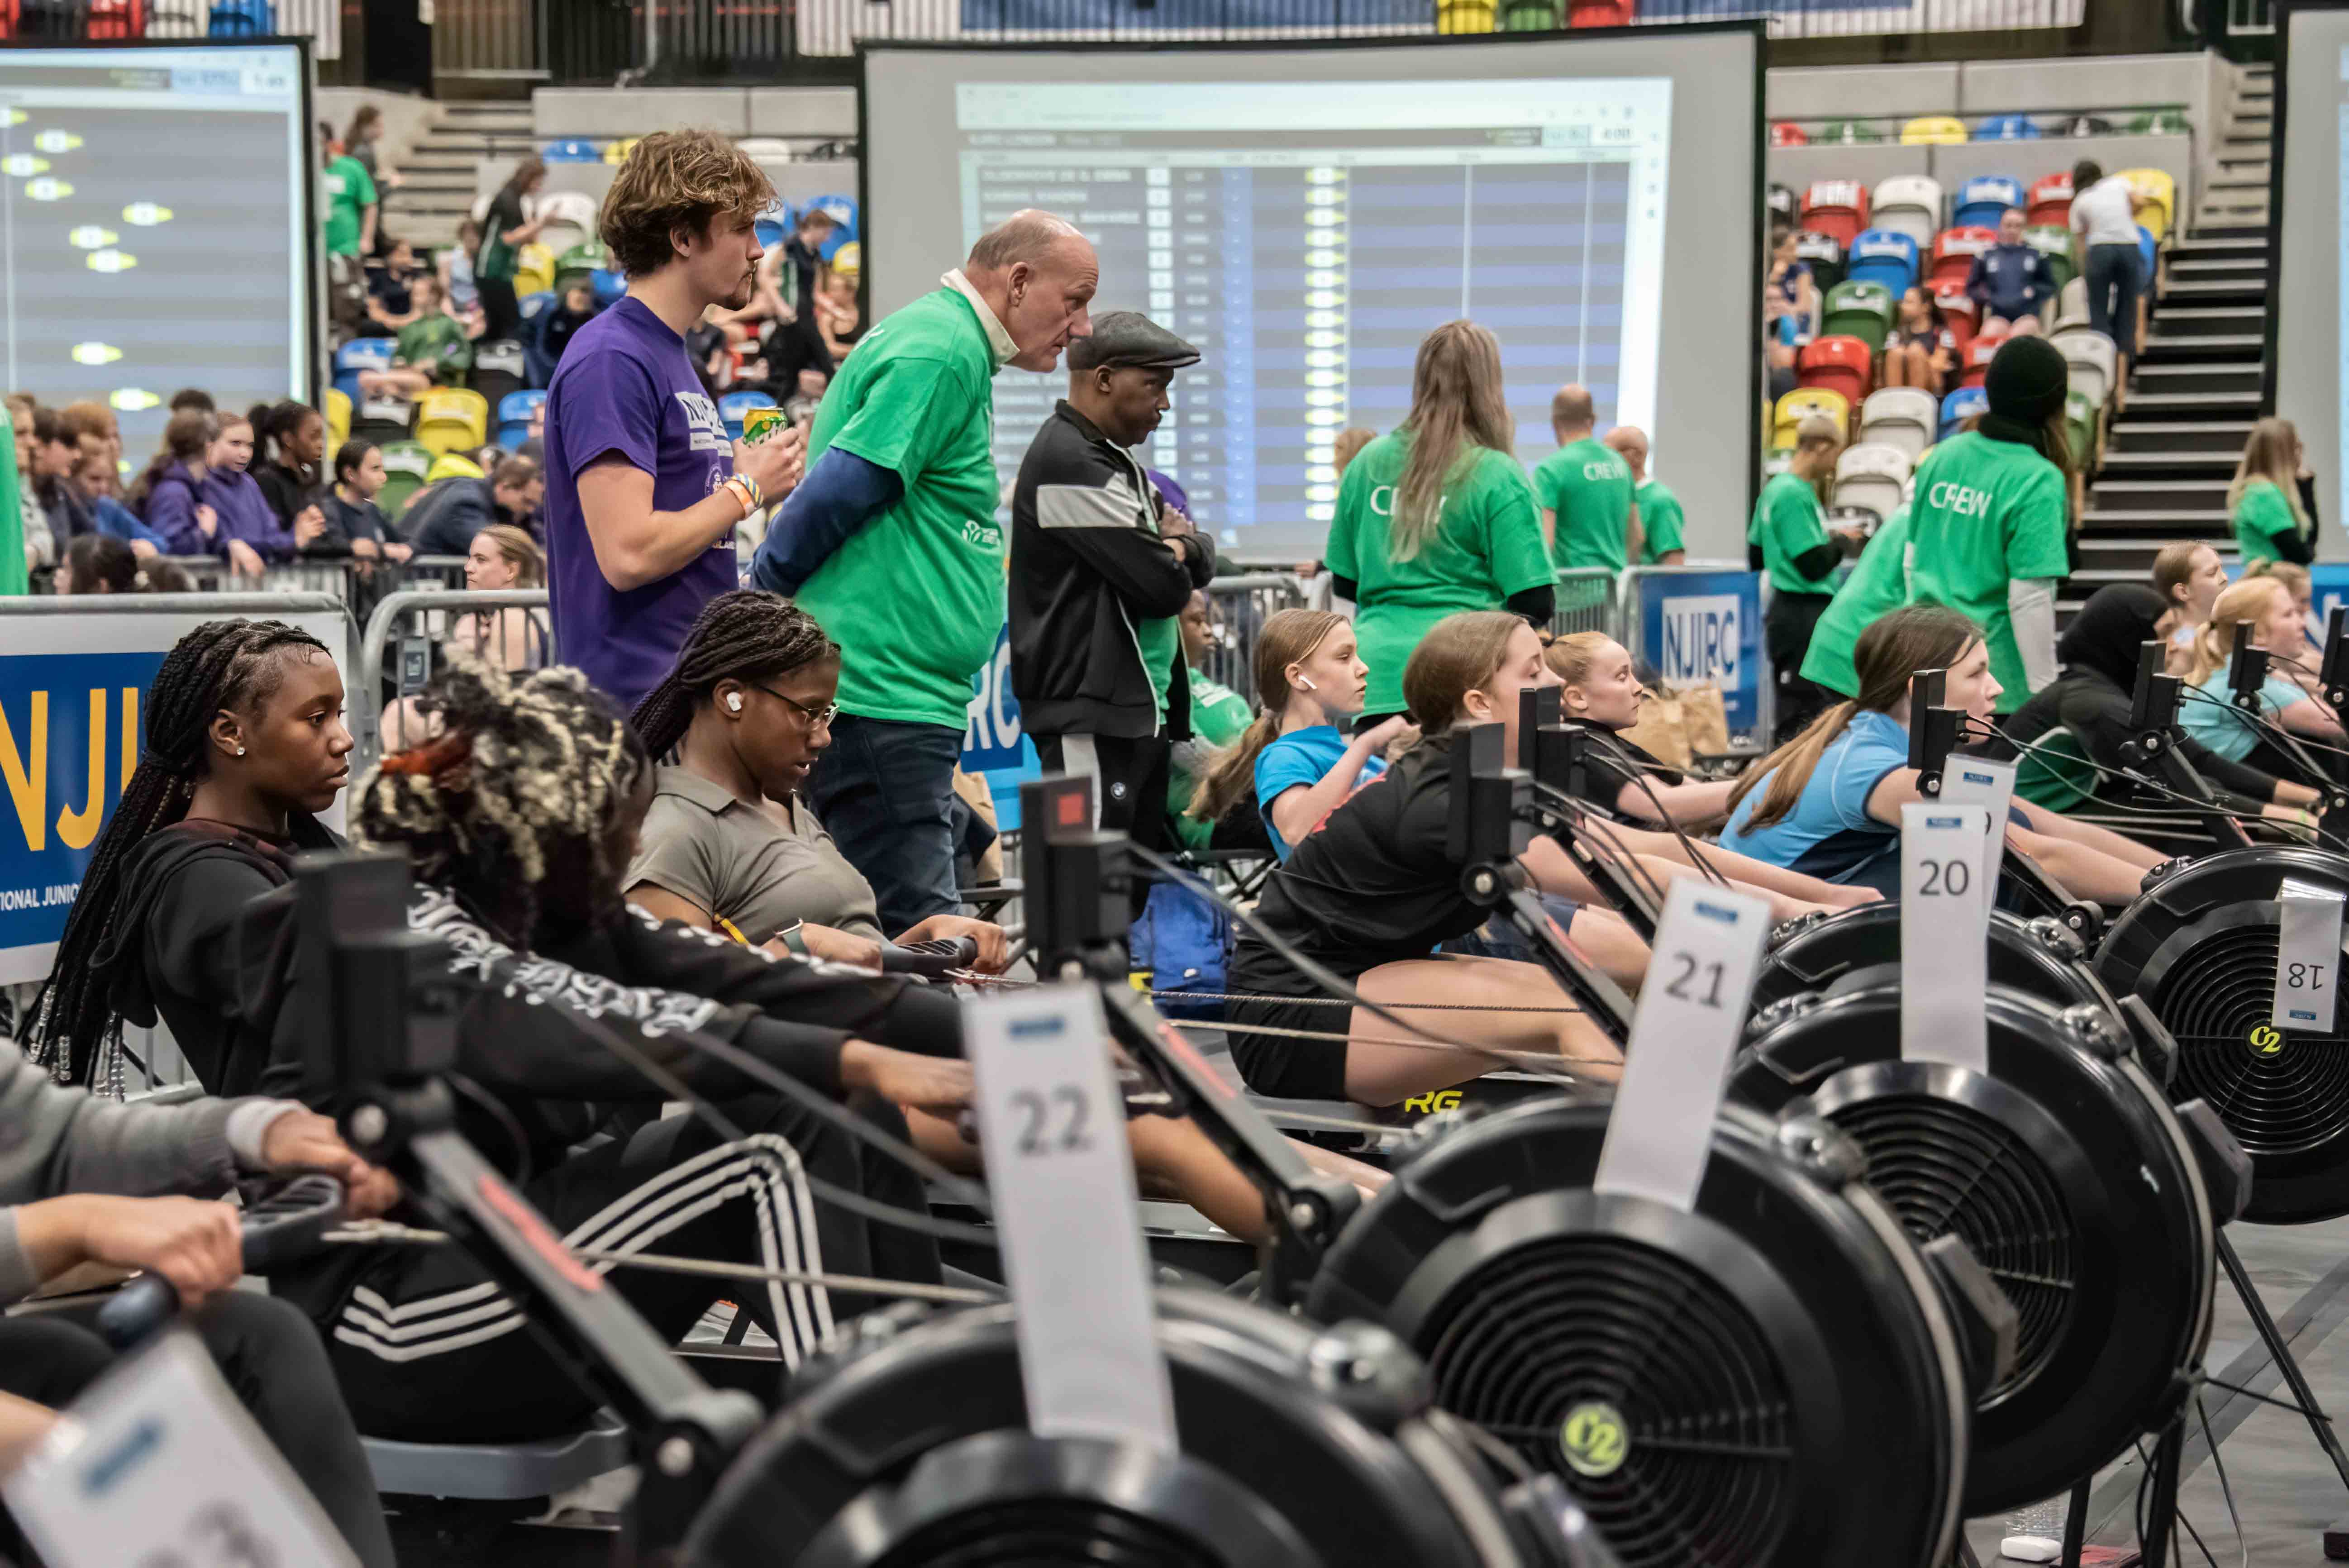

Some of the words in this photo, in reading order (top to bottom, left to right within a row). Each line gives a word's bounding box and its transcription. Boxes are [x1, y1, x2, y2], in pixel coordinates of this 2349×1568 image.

[1929, 481, 1993, 519] CREW
[1665, 610, 1734, 680] NJIRC
[1919, 859, 1970, 896] 20
[0, 888, 40, 911] IONAL
[42, 883, 82, 906] JUNIO
[1665, 952, 1726, 1008] 21
[2287, 963, 2324, 990] 18
[2249, 1026, 2282, 1053] C2
[1010, 1084, 1092, 1158] 22
[1564, 1410, 1621, 1462] C2
